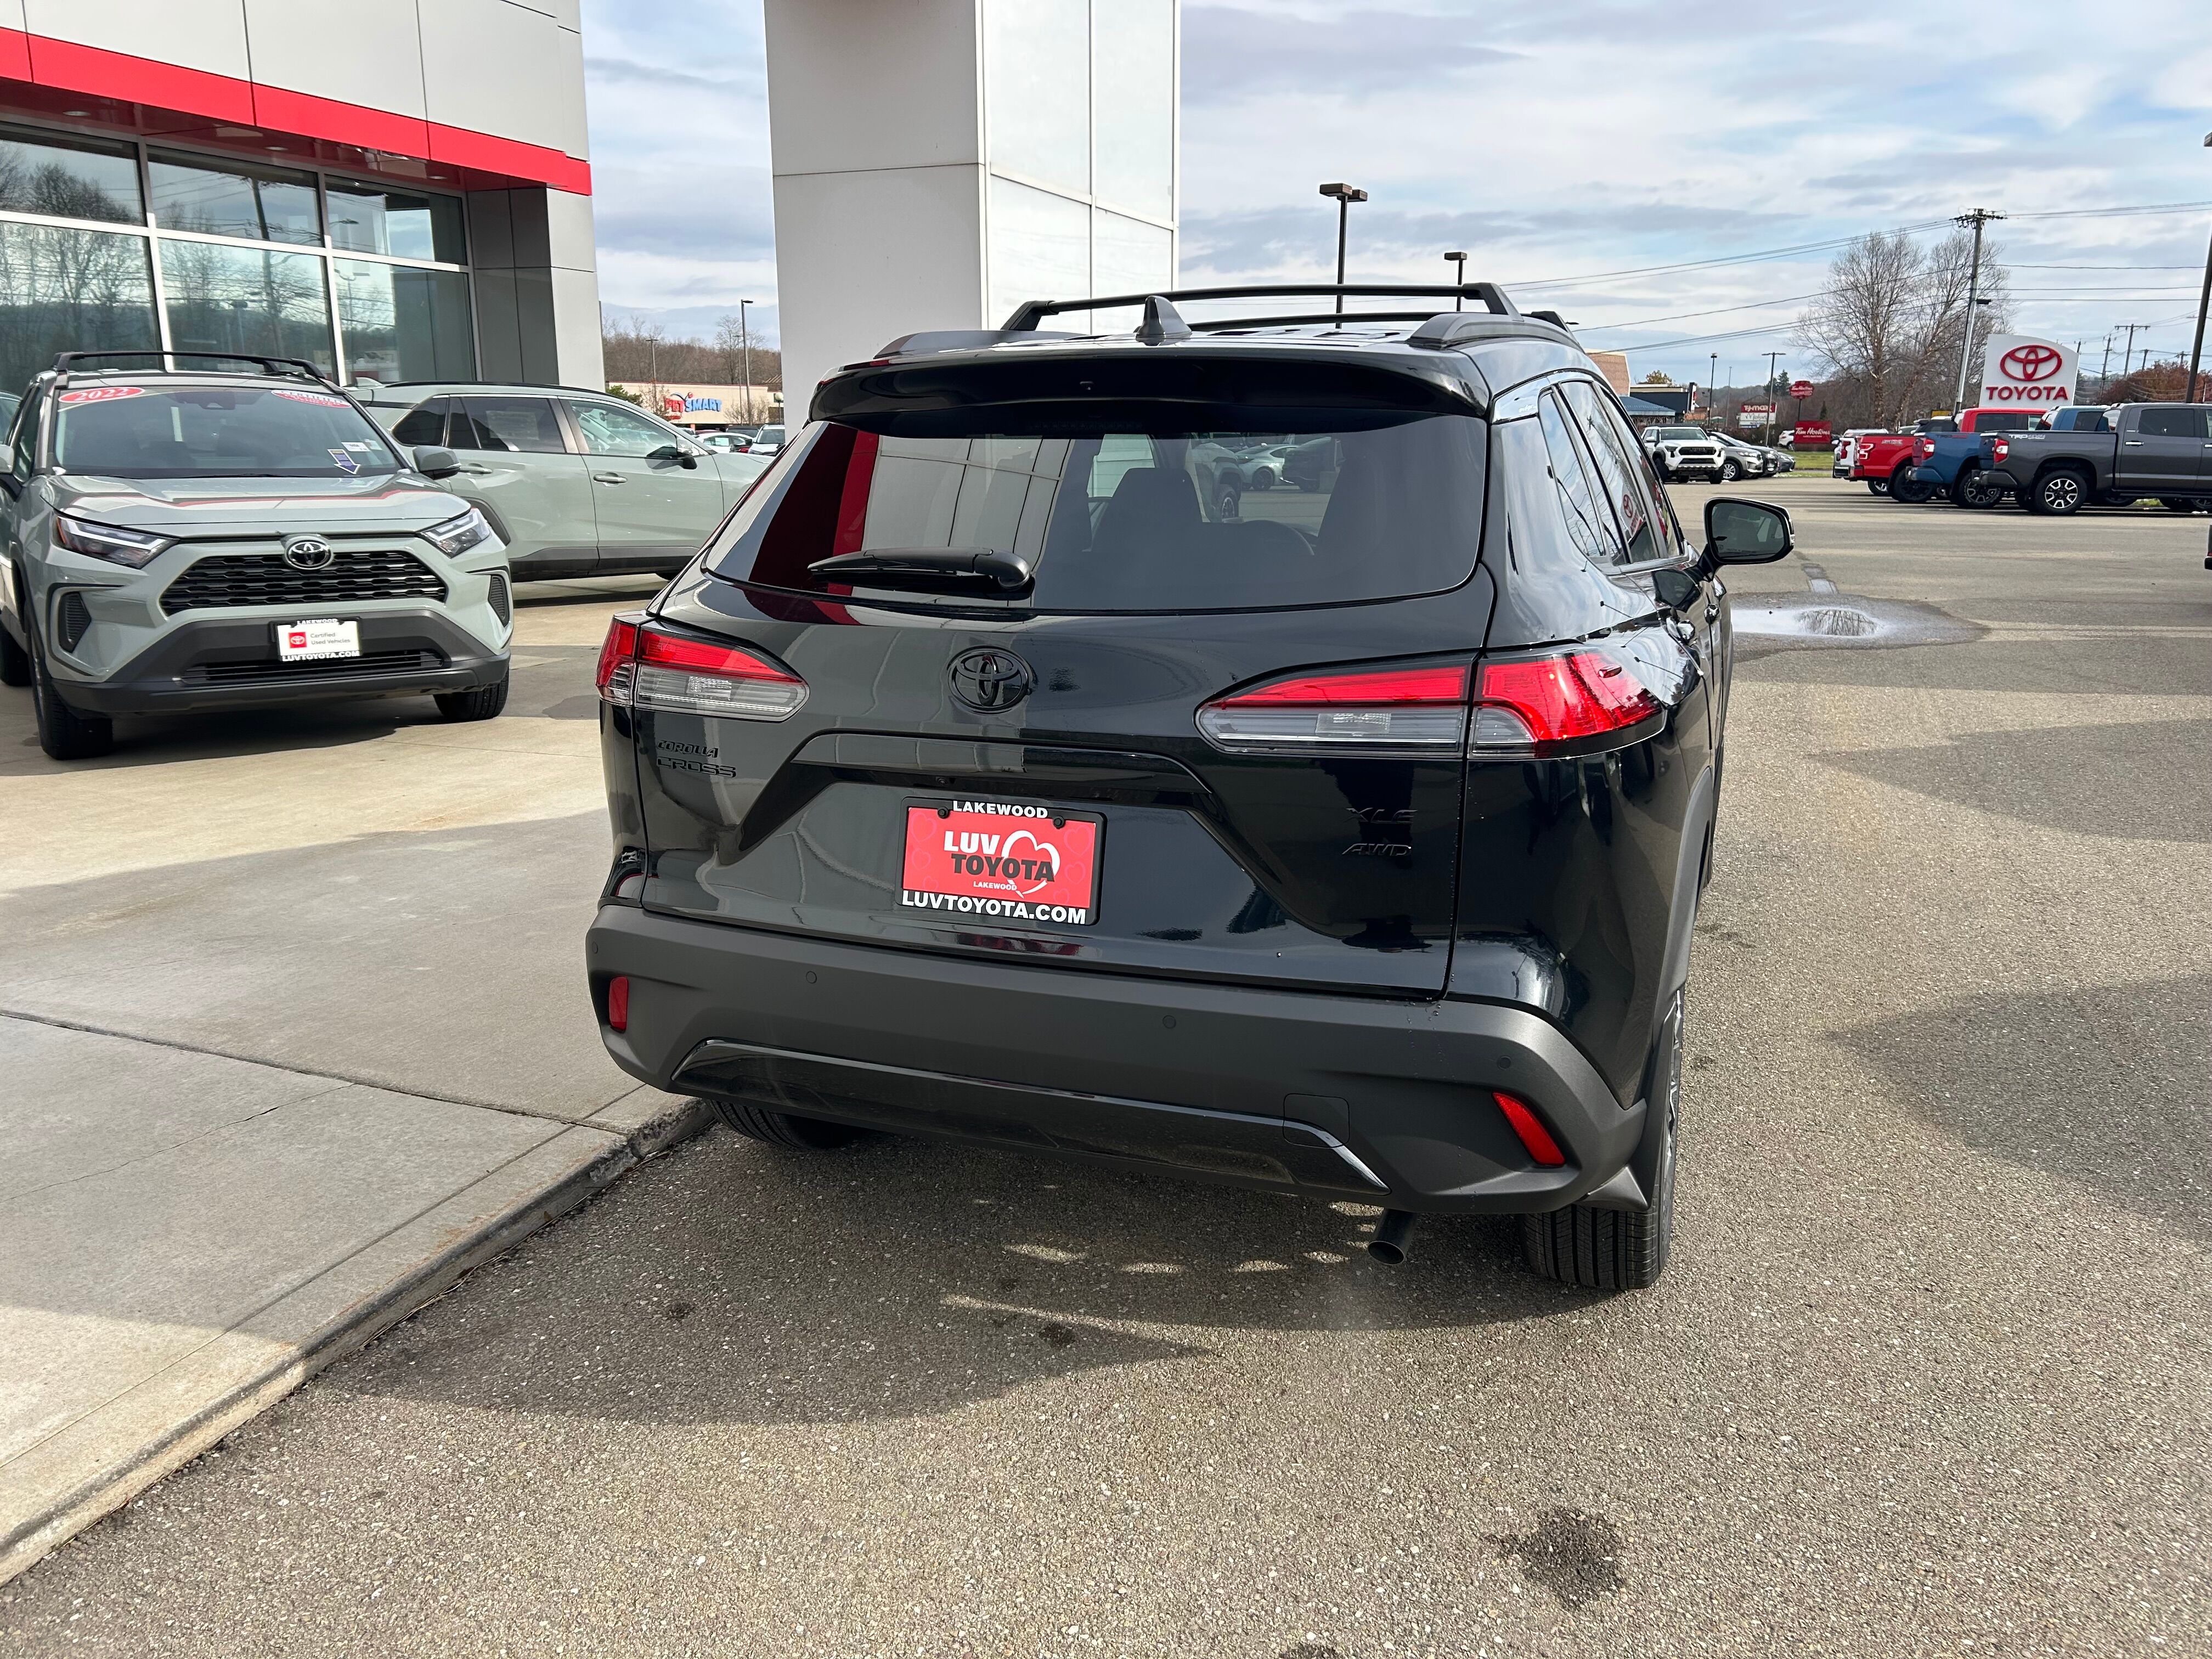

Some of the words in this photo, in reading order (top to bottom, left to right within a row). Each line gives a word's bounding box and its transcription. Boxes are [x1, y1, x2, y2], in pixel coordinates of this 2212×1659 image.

[75, 387, 128, 401] 2022
[1986, 386, 2068, 400] TOYOTA
[1796, 427, 1807, 435] Tim
[1807, 427, 1830, 435] Hortons
[282, 650, 360, 662] LUVTOYOTA.COM
[658, 740, 719, 758] COROLLA
[657, 756, 736, 778] CROSS
[952, 800, 1048, 819] LAKEWOOD
[1344, 807, 1418, 823] XLE
[943, 830, 1001, 855] LUV
[1342, 843, 1412, 856] AWD
[951, 853, 1055, 882] TOYOTA
[973, 881, 1018, 891] LAKEWOOD
[902, 889, 1087, 925] LUVTOYOTA.COM
